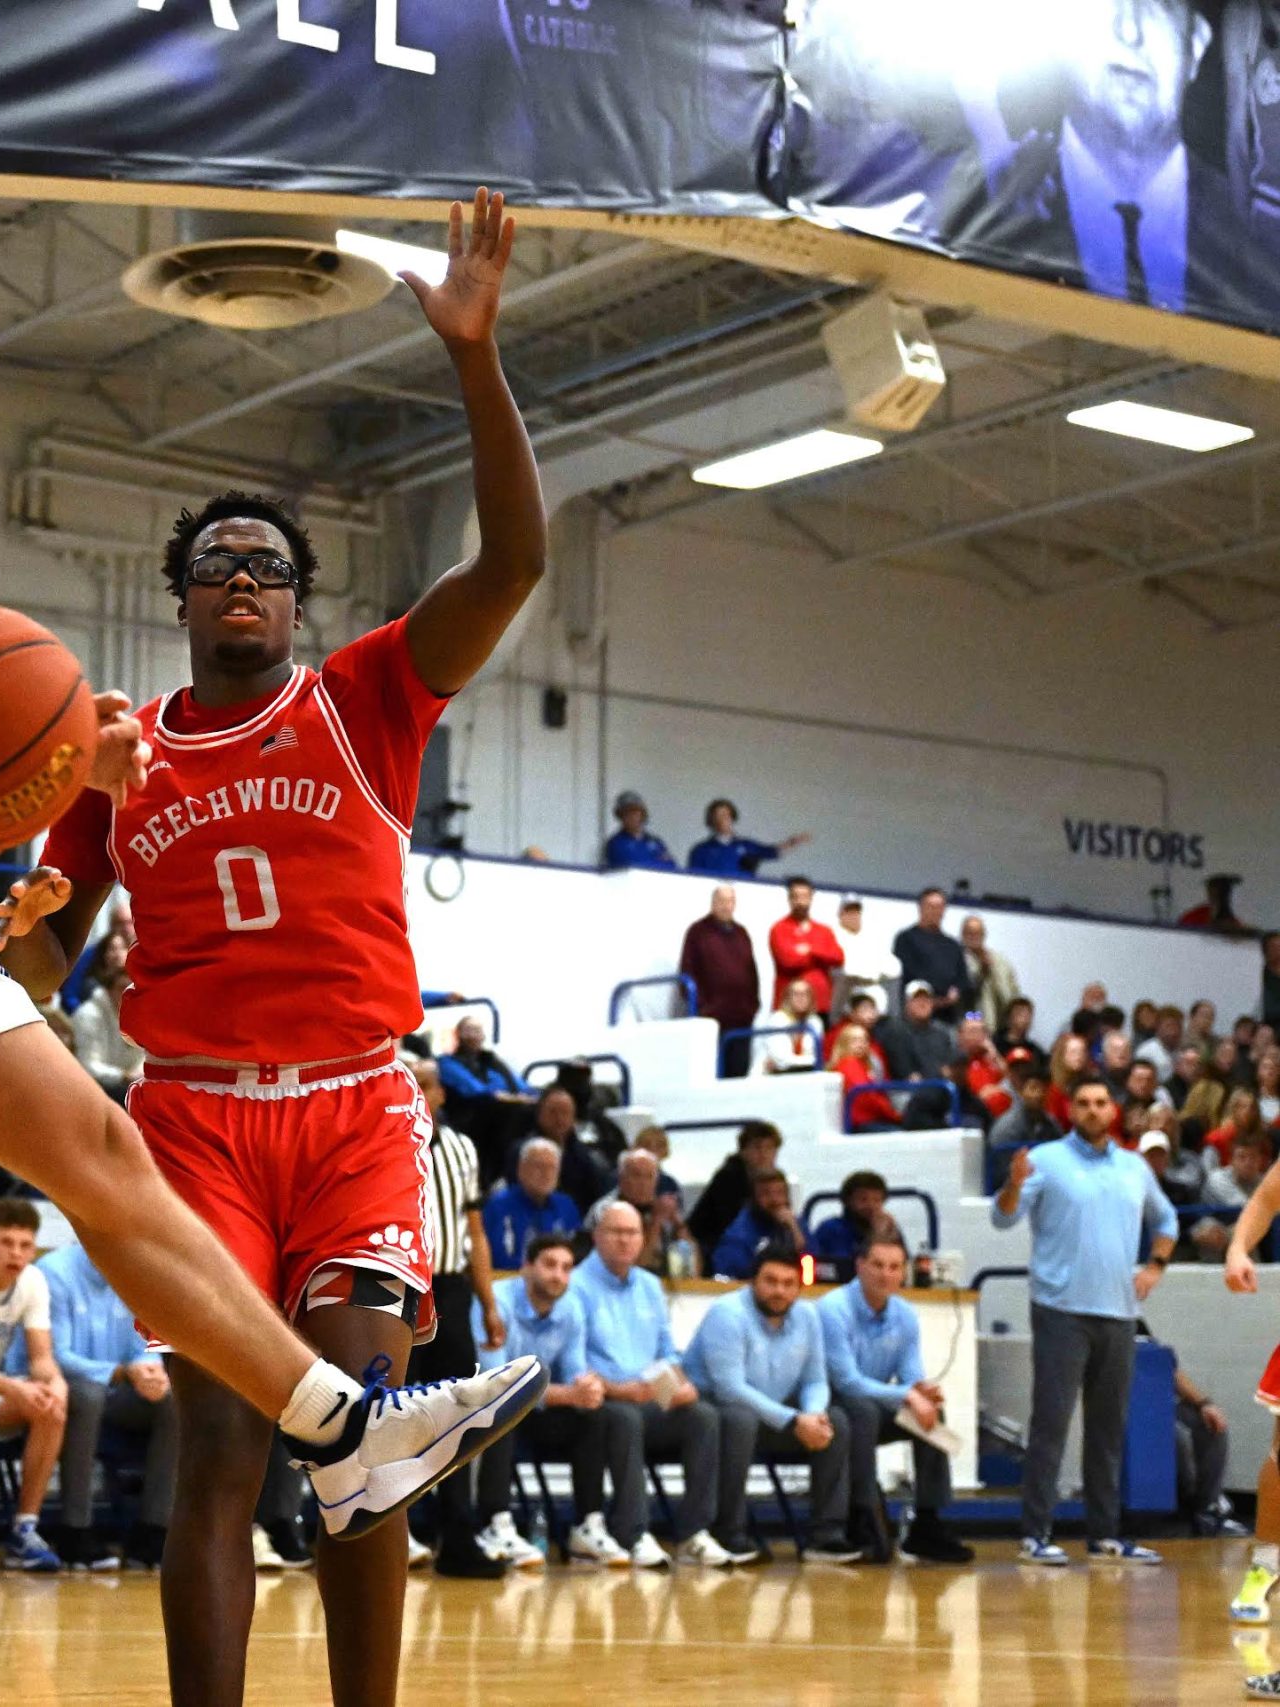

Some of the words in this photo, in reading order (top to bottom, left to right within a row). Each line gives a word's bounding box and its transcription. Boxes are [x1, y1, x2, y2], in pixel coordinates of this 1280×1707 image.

[128, 776, 342, 868] BEECHWOOD
[1064, 817, 1204, 870] VISITORS
[214, 845, 281, 931] 0
